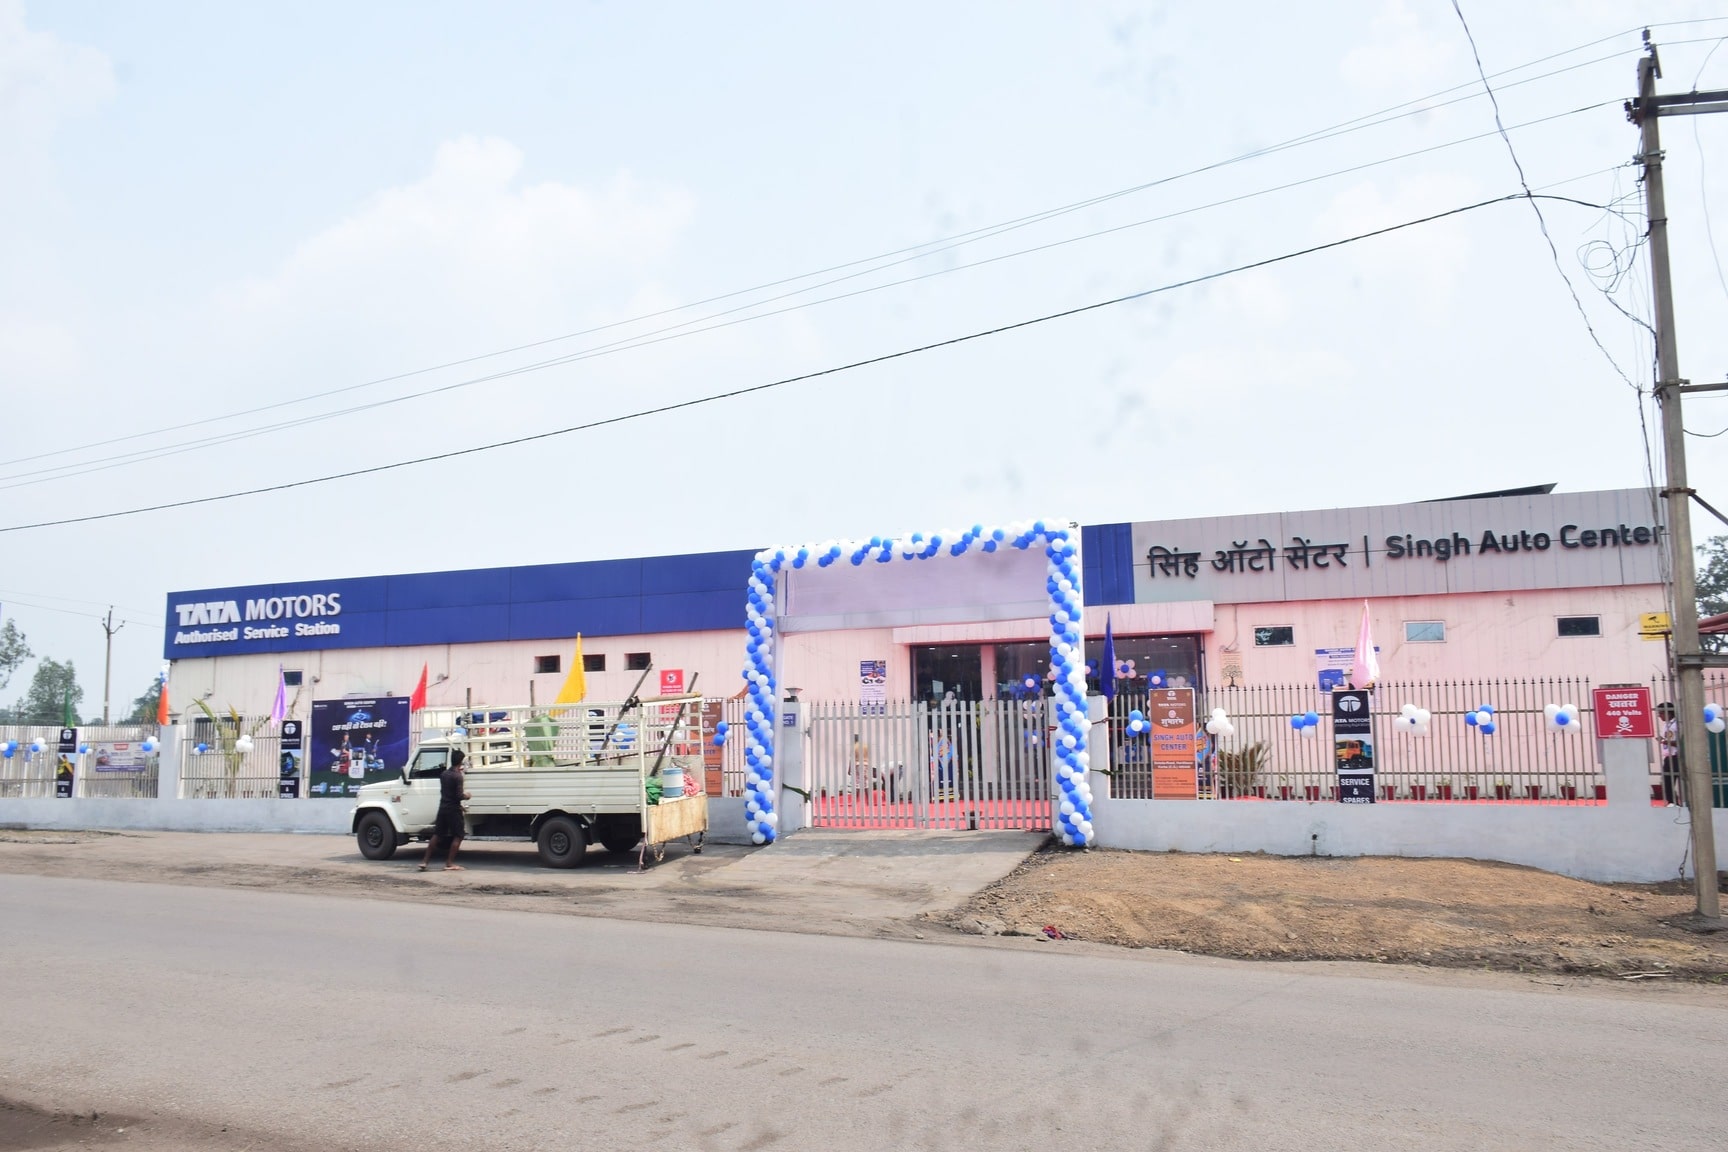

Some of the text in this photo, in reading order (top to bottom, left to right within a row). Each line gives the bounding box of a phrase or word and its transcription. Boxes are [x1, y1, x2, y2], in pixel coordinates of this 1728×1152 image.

[1385, 523, 1664, 561] Singh Auto Center
[1147, 536, 1349, 578] सिंह ऑटो सेंटर
[175, 593, 342, 627] TATA MOTORS
[174, 621, 341, 645] Authorised Service Station
[1176, 733, 1193, 741] AUTO
[1341, 778, 1370, 786] SERVICE
